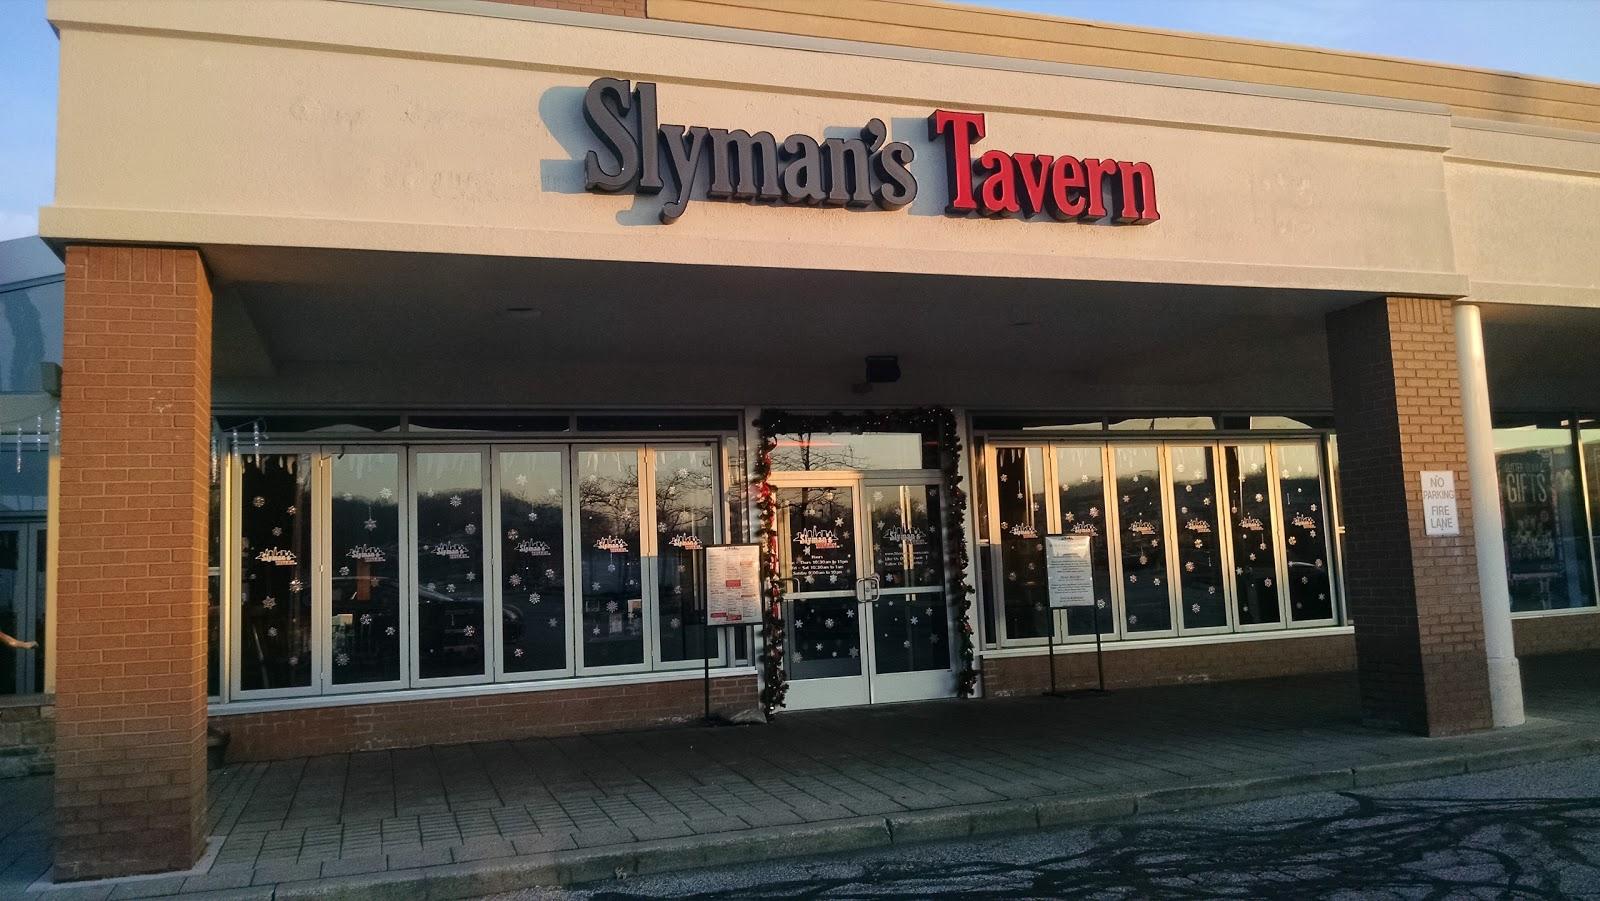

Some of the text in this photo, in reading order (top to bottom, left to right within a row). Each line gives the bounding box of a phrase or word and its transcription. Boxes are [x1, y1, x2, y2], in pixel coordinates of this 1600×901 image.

[583, 78, 1161, 225] Slyman's Tavern
[1430, 476, 1445, 488] NO
[1506, 472, 1548, 503] GIFTS
[1423, 490, 1455, 500] PARKING
[1431, 505, 1450, 516] FIRE
[1430, 517, 1454, 529] LANE
